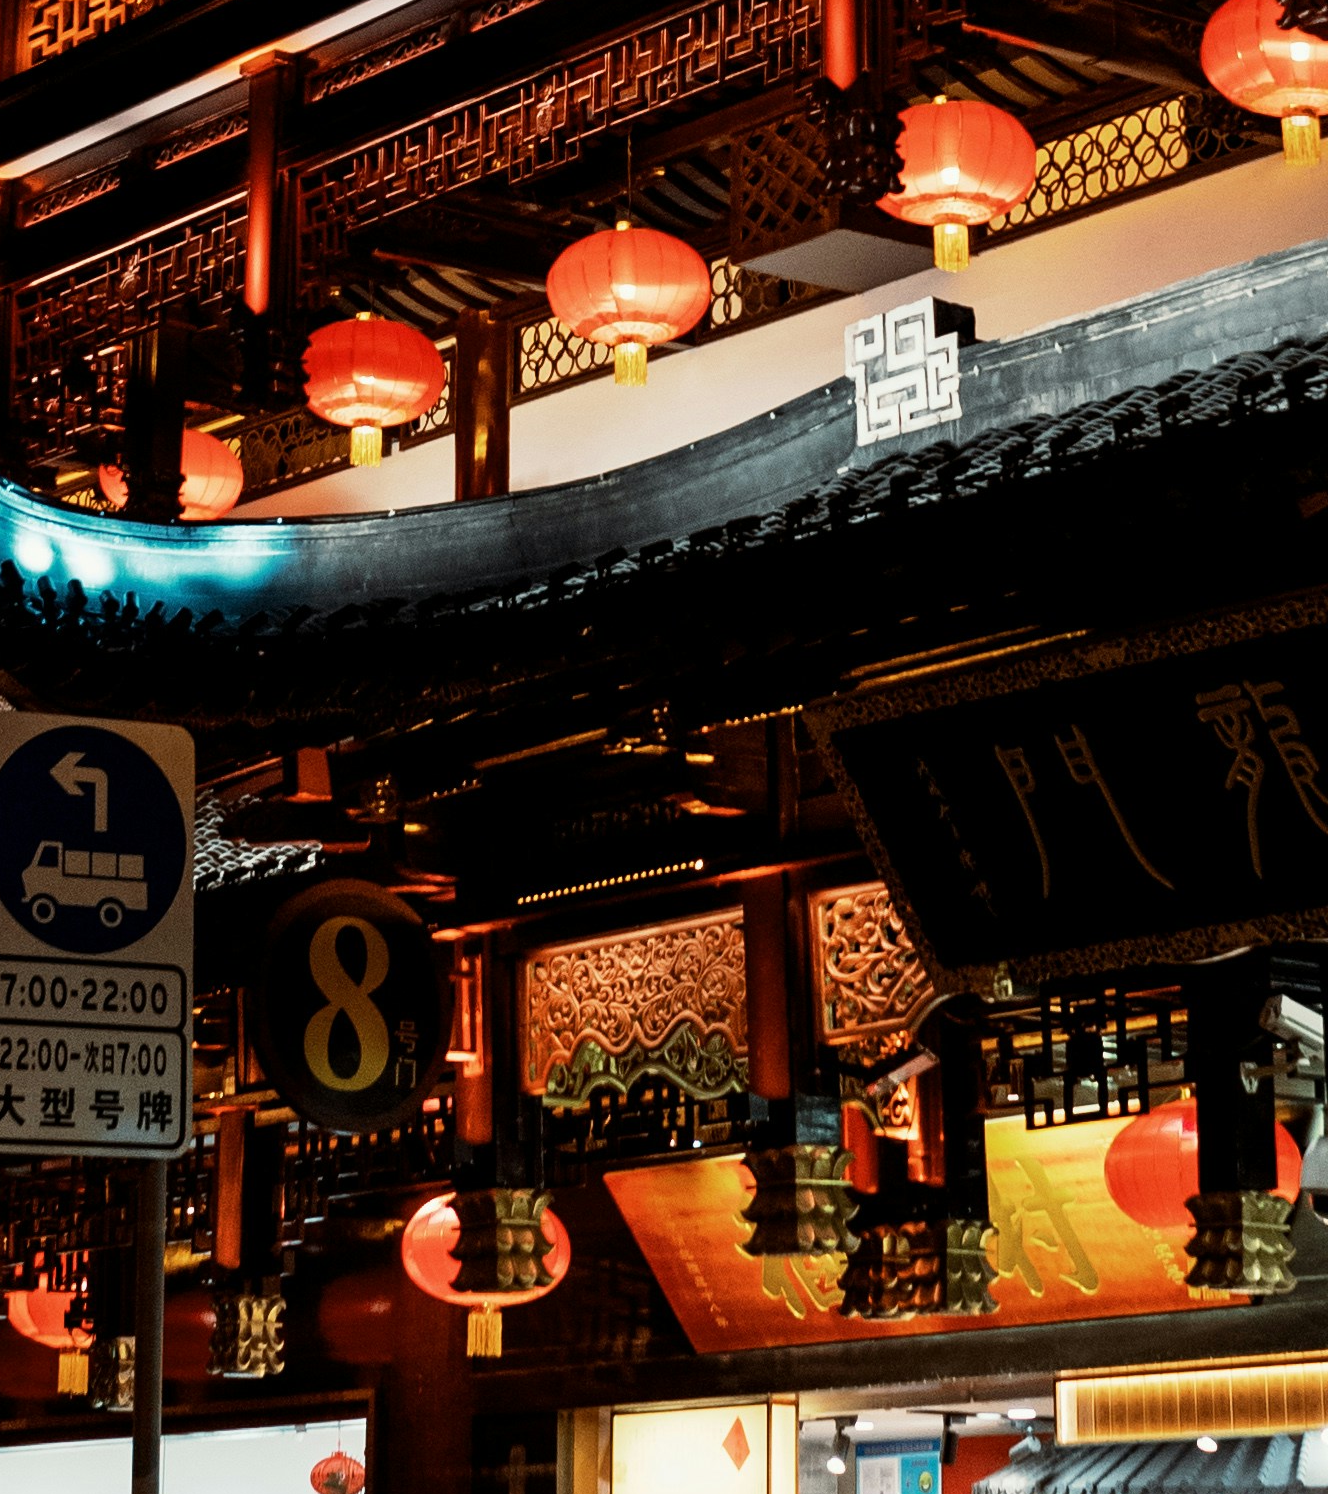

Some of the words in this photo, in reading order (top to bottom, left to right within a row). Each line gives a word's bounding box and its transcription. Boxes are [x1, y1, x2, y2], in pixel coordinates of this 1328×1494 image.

[0, 973, 168, 1015] 7:00-22:00
[303, 915, 391, 1093] 8
[0, 1037, 167, 1077] 22:00-次日7:00
[393, 1019, 420, 1089] 号门
